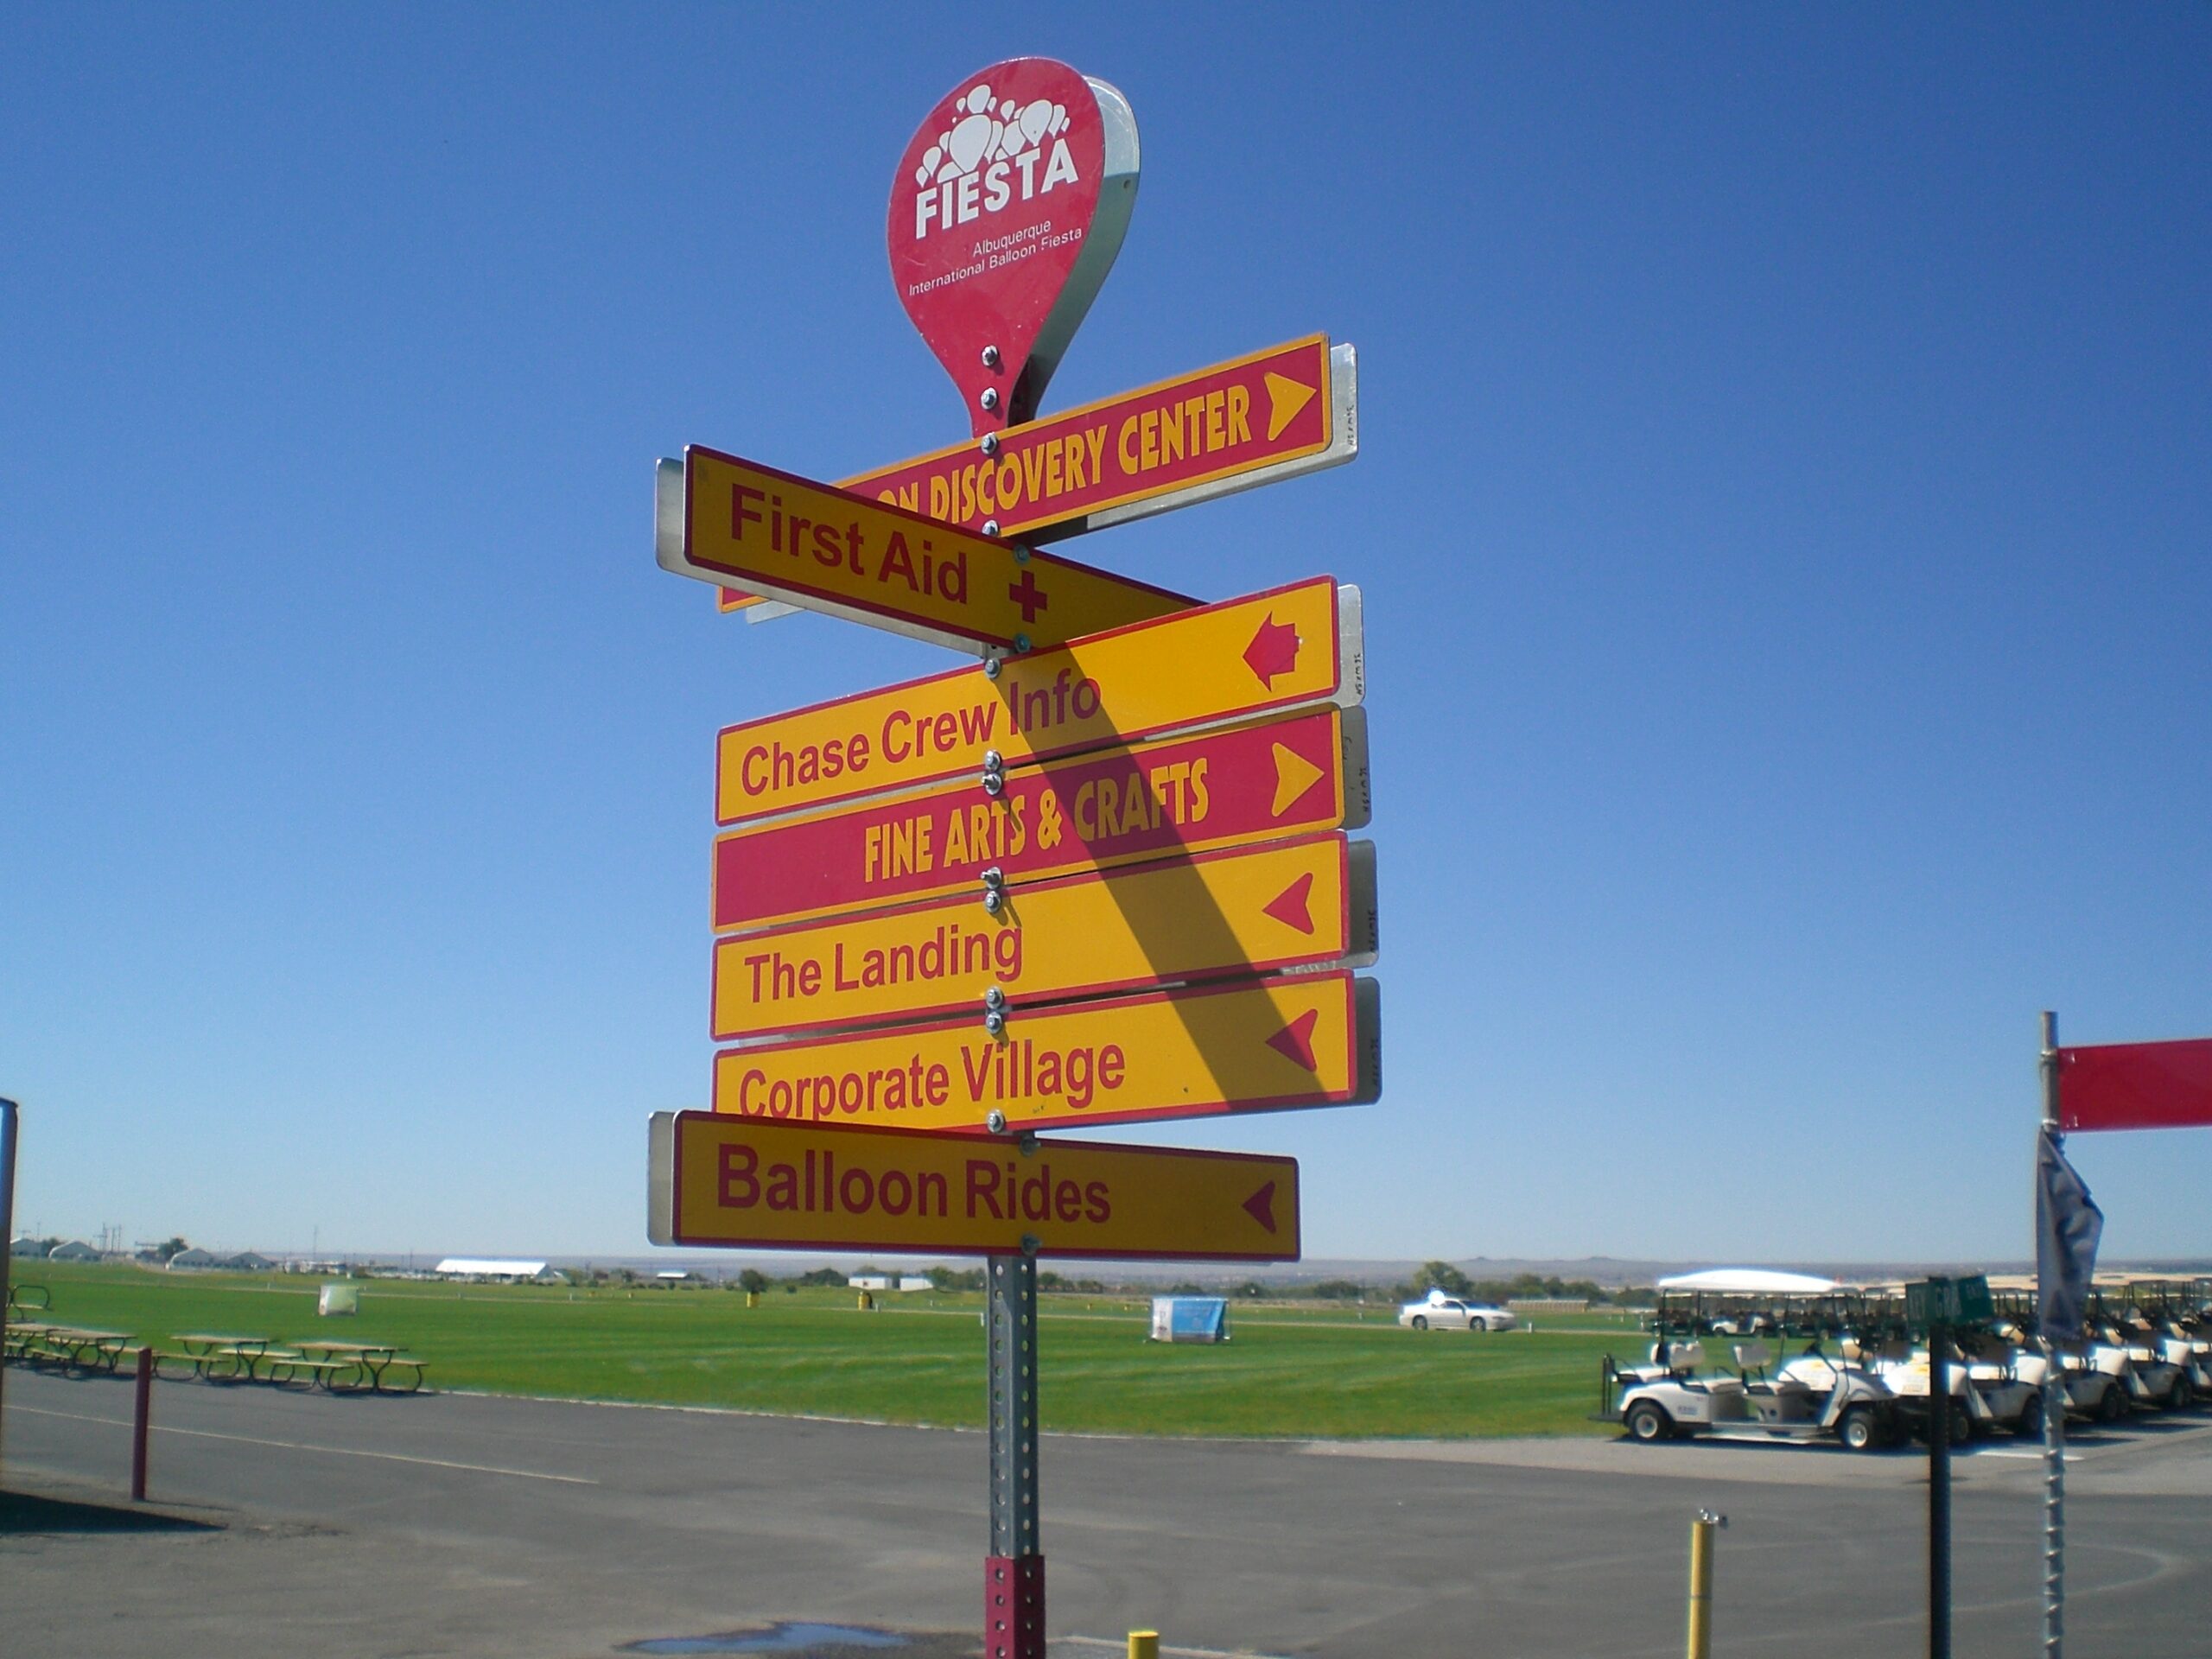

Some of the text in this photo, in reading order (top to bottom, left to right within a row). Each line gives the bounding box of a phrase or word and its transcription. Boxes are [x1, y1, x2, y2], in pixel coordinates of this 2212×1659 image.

[916, 138, 1078, 239] FIESTA
[909, 227, 1083, 296] International Balloon Fiesta
[973, 219, 1051, 257] Albuquerque
[931, 426, 1106, 524] DISCOVERY
[1117, 384, 1252, 476] CENTER
[731, 481, 969, 606] First Aid
[741, 666, 1103, 796] Chase Crew Info
[865, 758, 1211, 885] FINE ARTS & CRAFTS
[745, 921, 1023, 1004] The Landing
[739, 1038, 1126, 1120] Corporate Village
[718, 1142, 1112, 1224] Balloon Rides
